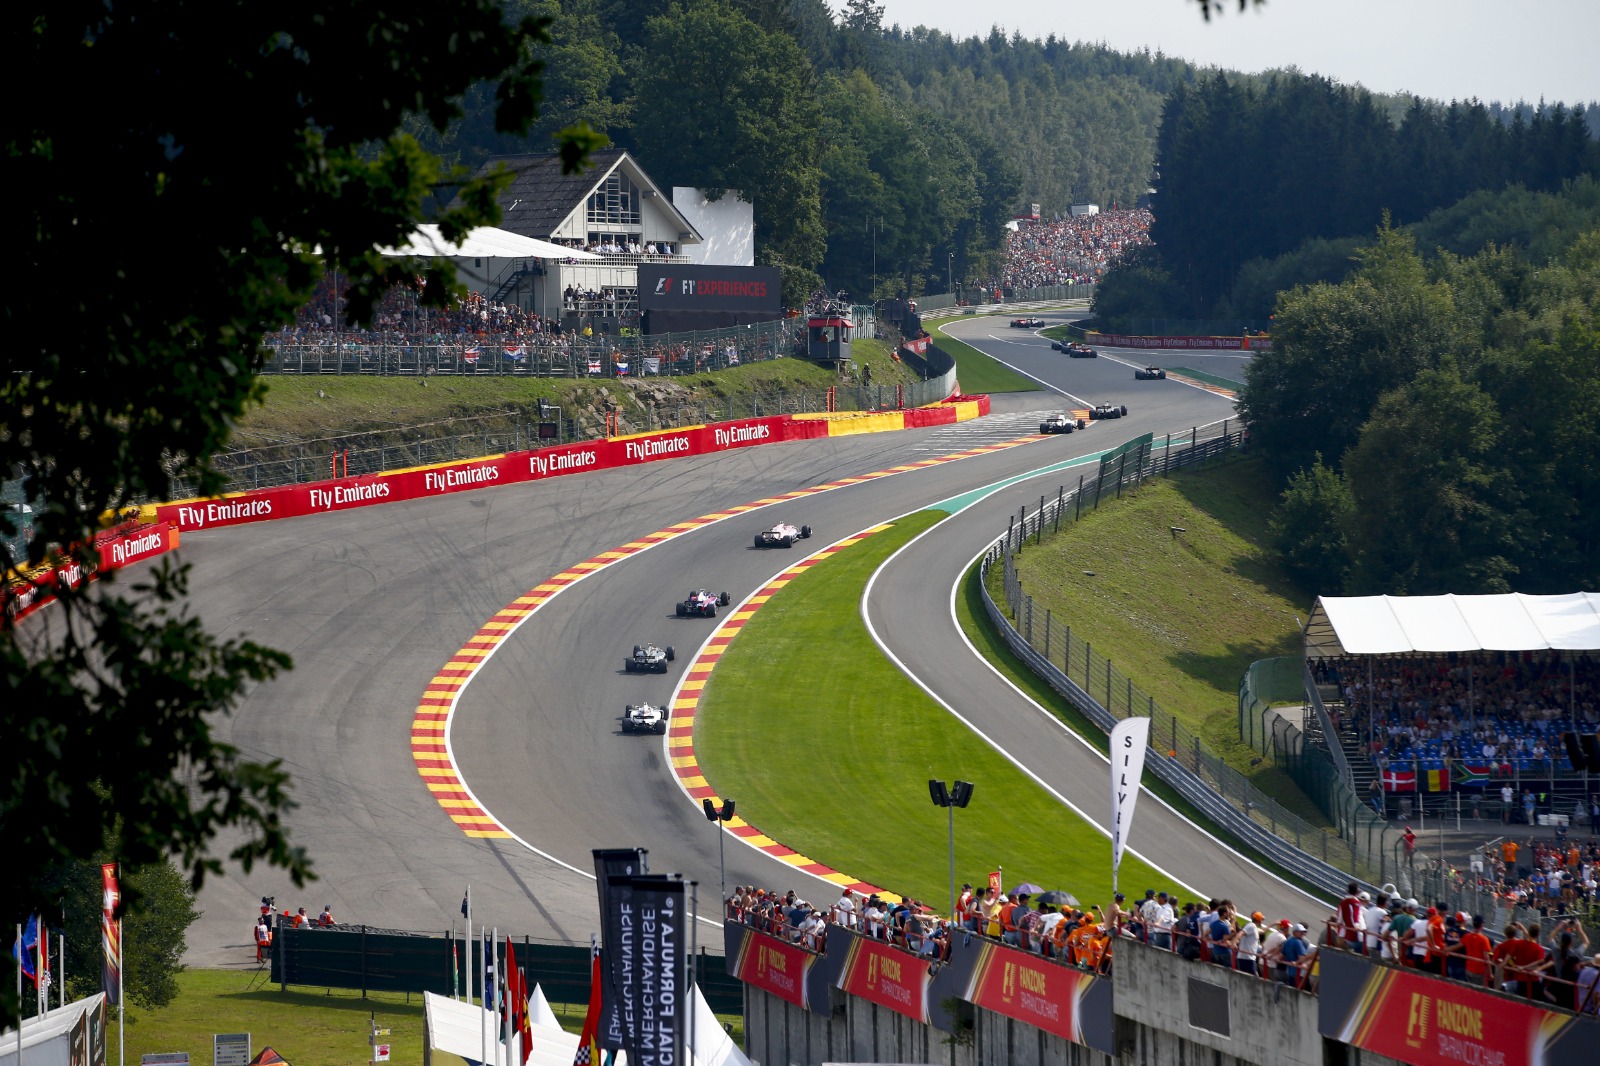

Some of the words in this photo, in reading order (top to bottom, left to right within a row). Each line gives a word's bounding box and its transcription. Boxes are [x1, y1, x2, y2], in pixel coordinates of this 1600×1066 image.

[697, 280, 767, 297] EXPERIENCES
[626, 442, 644, 460] Fly
[644, 436, 689, 456] Emirates
[715, 428, 730, 447] Fly
[730, 424, 770, 443] Emirates
[530, 456, 547, 475] Fly
[549, 450, 596, 471] Emirates
[425, 472, 445, 491] Fly
[446, 465, 499, 486] Emirates
[309, 489, 332, 509] Fly
[334, 482, 390, 504] Emirates
[178, 507, 204, 527] Fly
[207, 499, 272, 522] Emirates
[112, 543, 125, 563] Fly
[125, 532, 161, 558] Emirates
[881, 955, 901, 983] FANZONE
[1020, 965, 1045, 996] FANZONE
[1437, 998, 1483, 1040] FANZONE
